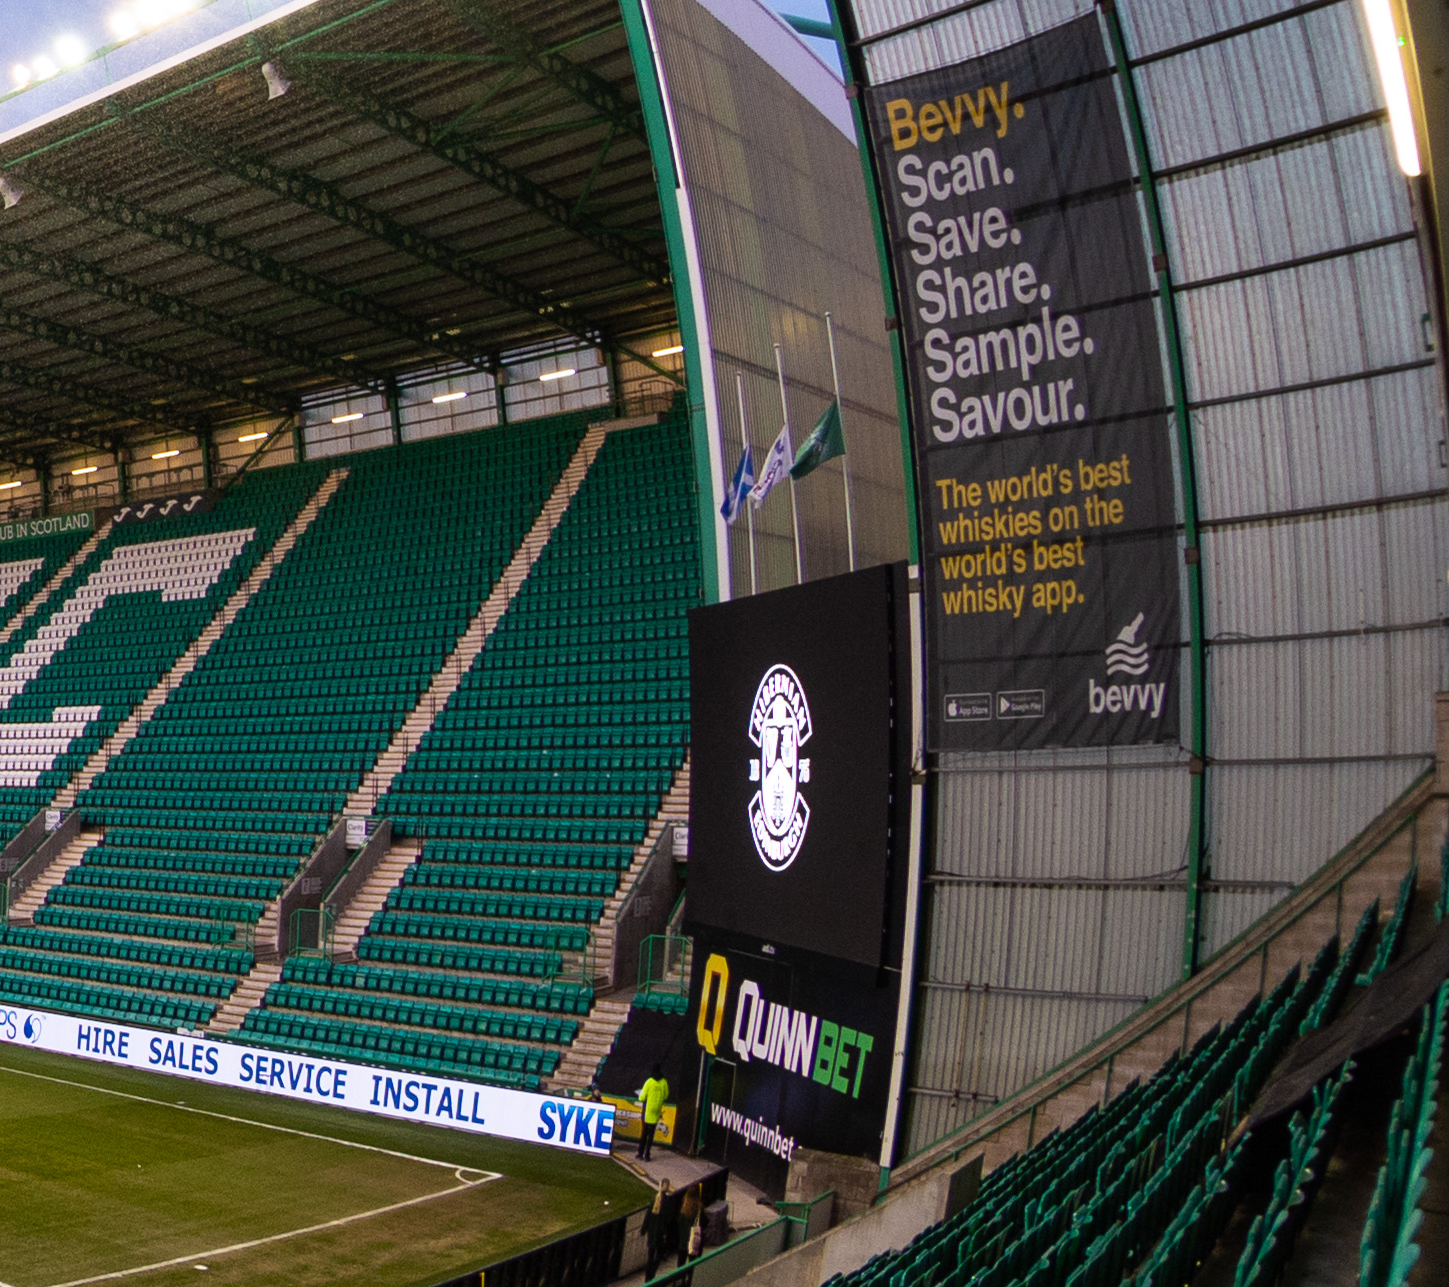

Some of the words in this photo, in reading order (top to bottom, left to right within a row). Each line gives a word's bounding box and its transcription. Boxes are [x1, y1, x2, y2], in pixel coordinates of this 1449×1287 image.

[886, 81, 1025, 151] Bevvy.
[897, 147, 1015, 208] Scan.
[907, 207, 1021, 265] Save.
[916, 262, 1051, 324] Share.
[924, 306, 1094, 382] Sample.
[930, 378, 1085, 442] Savour.
[935, 478, 982, 510] The
[986, 463, 1073, 503] world's
[1078, 454, 1132, 490] best
[16, 523, 28, 537] IN
[30, 513, 90, 537] SCOTLAND
[939, 507, 1042, 545] whiskies
[1049, 504, 1078, 532] on
[1085, 494, 1125, 526] the
[941, 543, 1026, 580] world's
[1033, 535, 1085, 571] best
[942, 580, 1025, 618] whisky
[1032, 579, 1085, 615] app.
[1089, 679, 1165, 718] bevvy
[697, 953, 729, 1055] Q
[733, 979, 874, 1099] QUINNBET
[77, 1025, 129, 1059] HIRE
[148, 1036, 218, 1076] SALES
[239, 1052, 347, 1100] SERVICE
[371, 1074, 486, 1126] INSTALL
[711, 1102, 796, 1162] www.quinnbet
